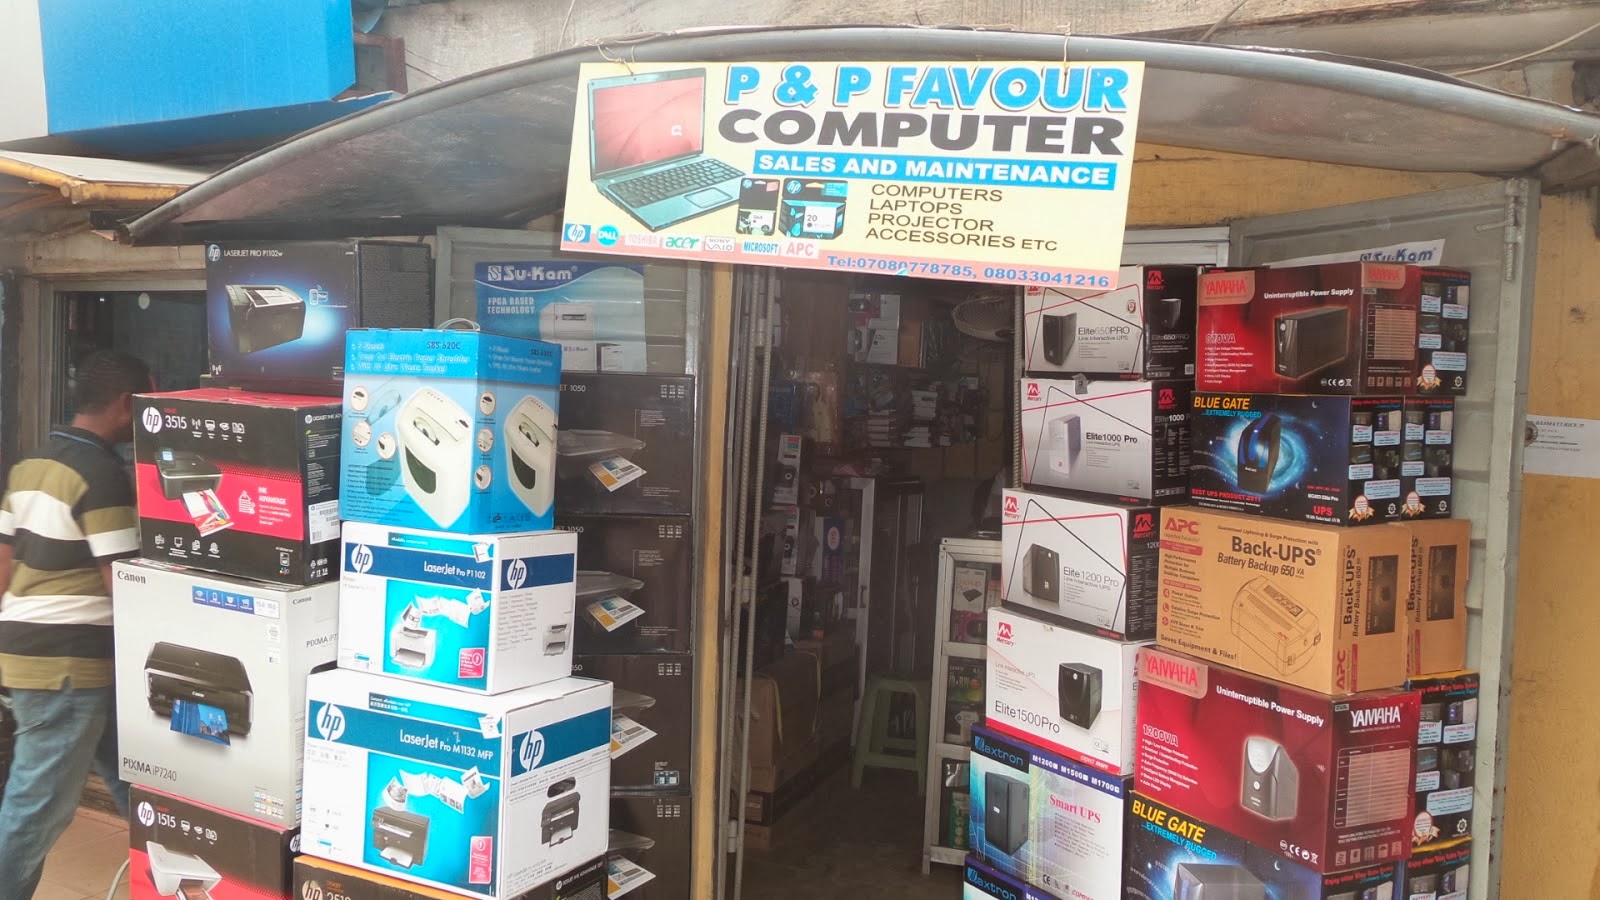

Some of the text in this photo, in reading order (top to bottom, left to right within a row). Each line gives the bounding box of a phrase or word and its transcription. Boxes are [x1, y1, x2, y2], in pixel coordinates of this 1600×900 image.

[724, 64, 1130, 114] P & P FAVOUR
[718, 109, 1125, 156] COMPUTER
[758, 154, 1110, 185] SALES AND MAINTENANCE
[871, 183, 1004, 202] COMPUTERS
[869, 198, 963, 215] LAPTOPS
[807, 214, 818, 222] 20
[868, 213, 994, 232] PROJECTOR
[628, 233, 658, 245] TOSHIBA
[665, 236, 700, 249] acer
[706, 243, 733, 251] VAIO
[743, 241, 779, 254] MICROSOFT
[865, 227, 1058, 251] ACCESSORIES ETC
[207, 244, 221, 262] hp
[786, 242, 814, 257] APC
[503, 265, 573, 281] Su-Kam
[983, 266, 1109, 288] 08033041216
[1370, 268, 1400, 281] YAMAHA
[1205, 279, 1247, 295] YAMAHA
[1264, 287, 1354, 300] Uninterruptible Power Supply
[487, 306, 535, 314] TECHNOLOGY
[509, 297, 535, 305] BASED
[441, 341, 461, 350] 620C
[569, 384, 587, 392] 1050
[1194, 396, 1250, 410] BLUE GATE
[142, 406, 163, 434] hp
[164, 414, 188, 430] 3515
[1236, 410, 1262, 419] RUGGED
[1086, 431, 1138, 444] Elite1000 Pro
[1207, 489, 1219, 497] UPS
[1313, 505, 1333, 516] UPS
[567, 526, 584, 534] 1050
[1165, 517, 1199, 536] APC
[1243, 528, 1264, 538] Lightning
[1282, 535, 1307, 543] Protection
[351, 543, 486, 580] hp LaserJet Pro P1102
[1217, 552, 1305, 577] Battery Backup 650 VA
[117, 570, 147, 585] Canon
[506, 557, 528, 590] hp
[1063, 566, 1119, 588] Elite 1200 Pro
[292, 596, 312, 605] Canon
[306, 635, 329, 648] PIXMA
[996, 636, 1015, 646] Mercury
[1160, 633, 1177, 644] Saves
[1178, 638, 1211, 653] Equipment
[1219, 649, 1237, 660] Files!
[1144, 654, 1199, 688] YAMAHA
[1335, 649, 1347, 691] APC
[1216, 684, 1324, 727] Uninterruptible Power Supply
[994, 700, 1061, 734] Elite1500Pro
[1350, 705, 1401, 728] YAMAHA
[316, 701, 494, 761] hp LaserJet Pro M1132 MFP
[1142, 723, 1179, 748] 1200VA
[518, 729, 545, 773] hp
[122, 756, 177, 782] PIXMA iP7240
[1080, 755, 1109, 770] expect more
[137, 801, 155, 827] hp
[1049, 793, 1102, 824] Smart UPS
[157, 811, 176, 829] 1515
[1132, 799, 1206, 844] BLUE GATE
[1184, 839, 1218, 861] RUGGED
